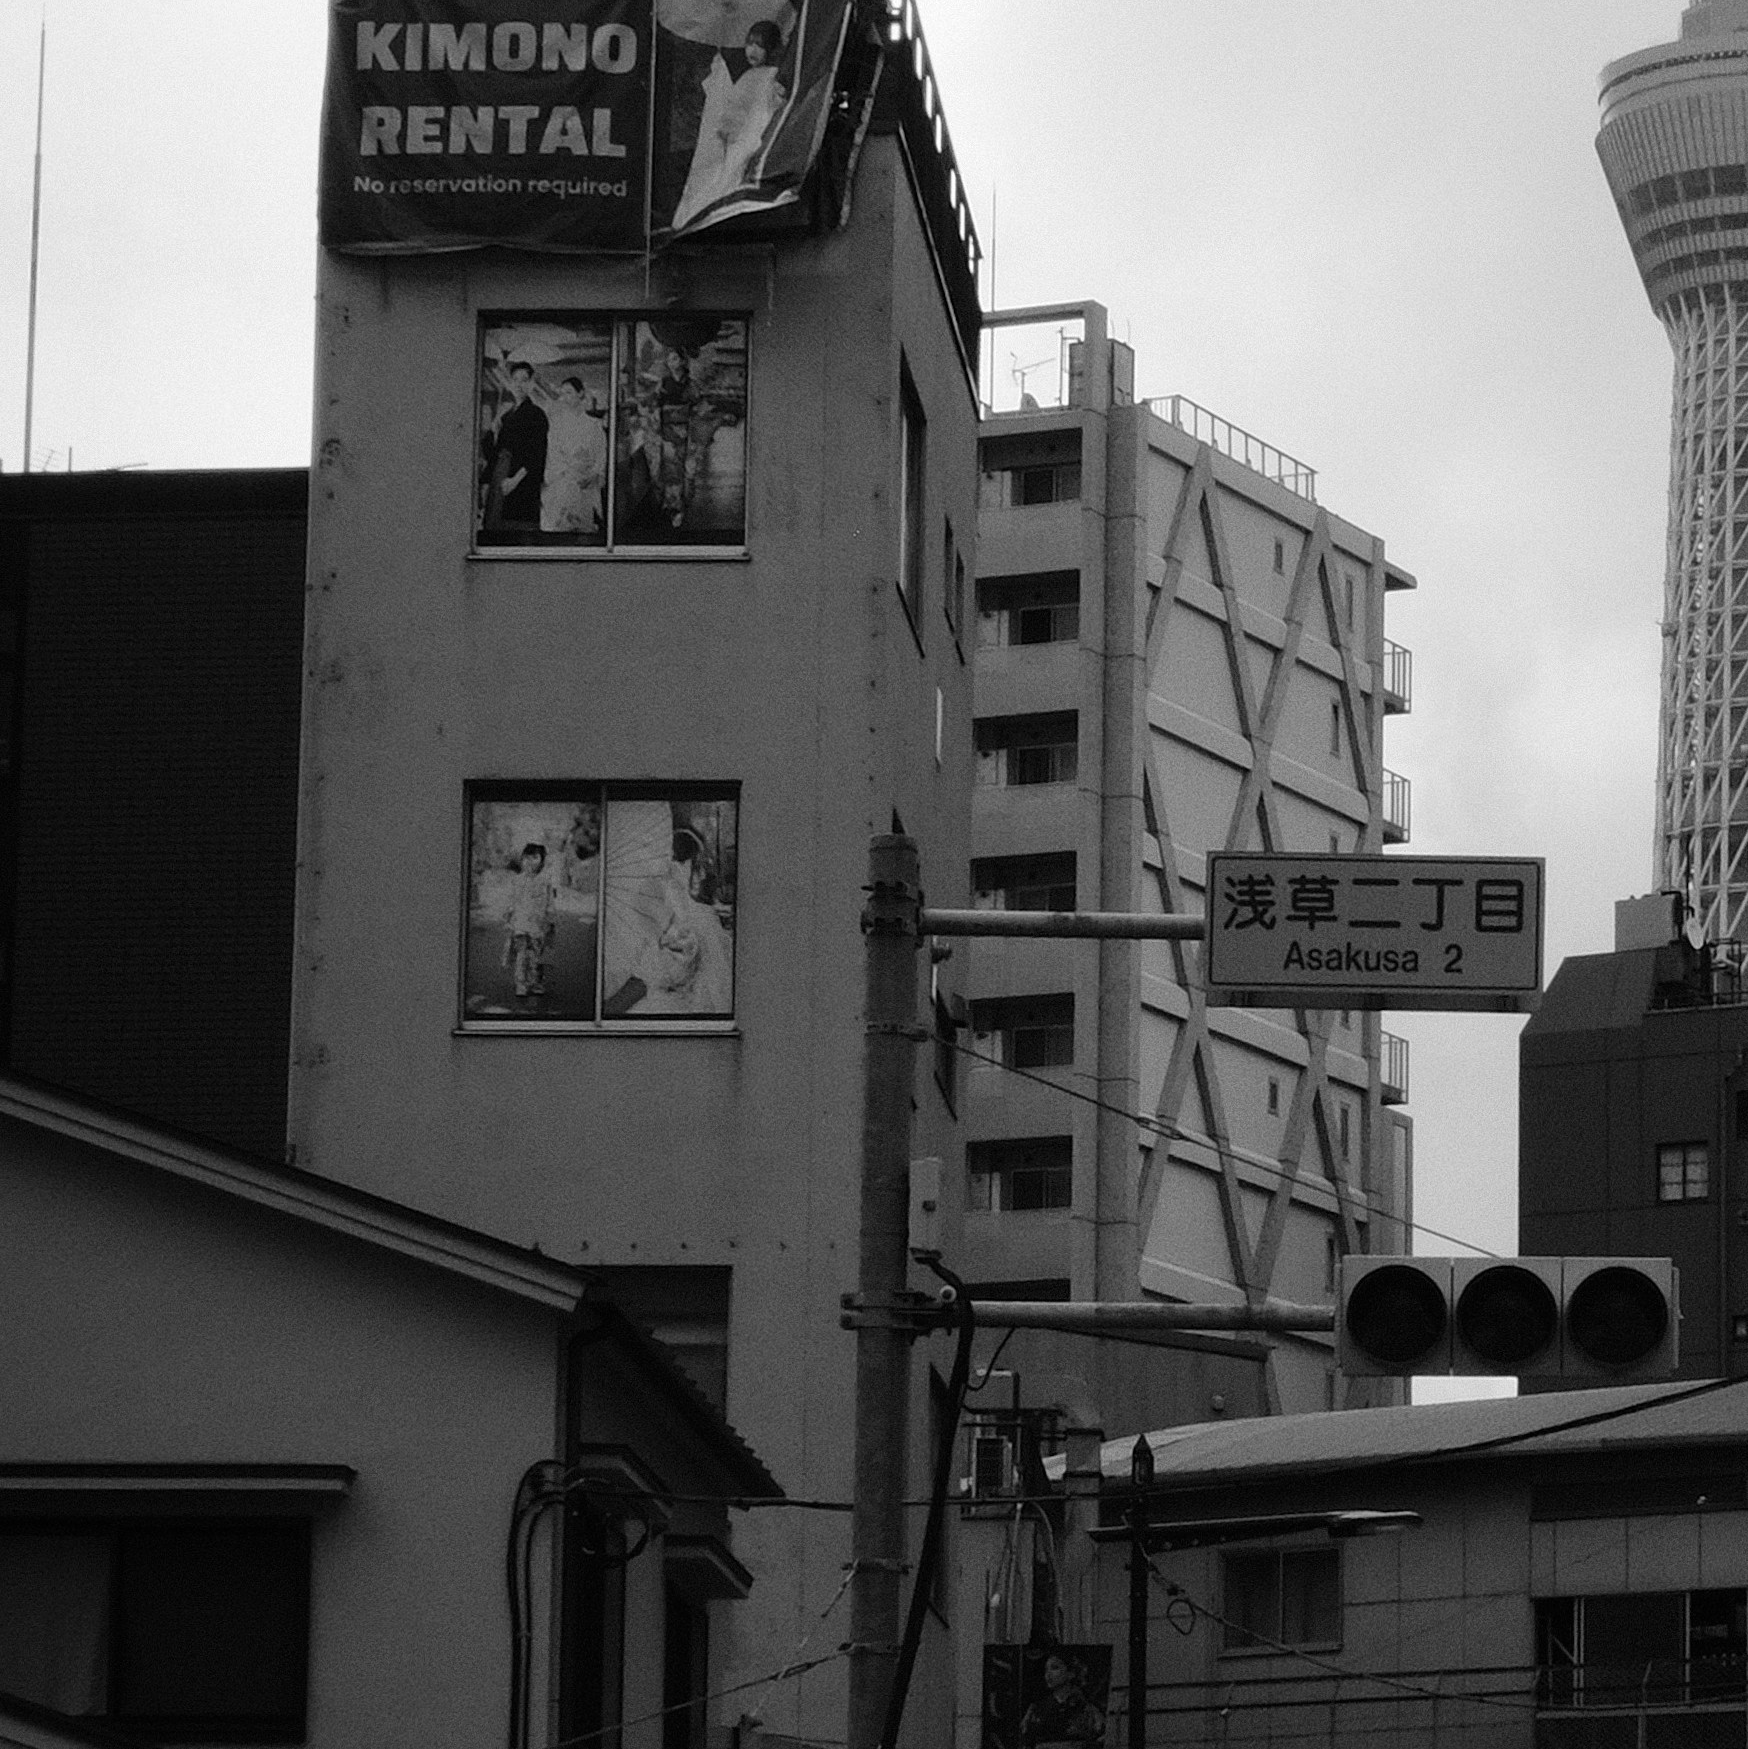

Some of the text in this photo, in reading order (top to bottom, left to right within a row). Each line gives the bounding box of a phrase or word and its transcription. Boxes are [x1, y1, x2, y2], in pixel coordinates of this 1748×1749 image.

[356, 21, 638, 75] KIMONO
[359, 105, 627, 158] RENTAL
[353, 175, 628, 201] No reservation required
[1223, 874, 1525, 933] 浅草二丁目
[1283, 941, 1464, 974] Asakusa 2
